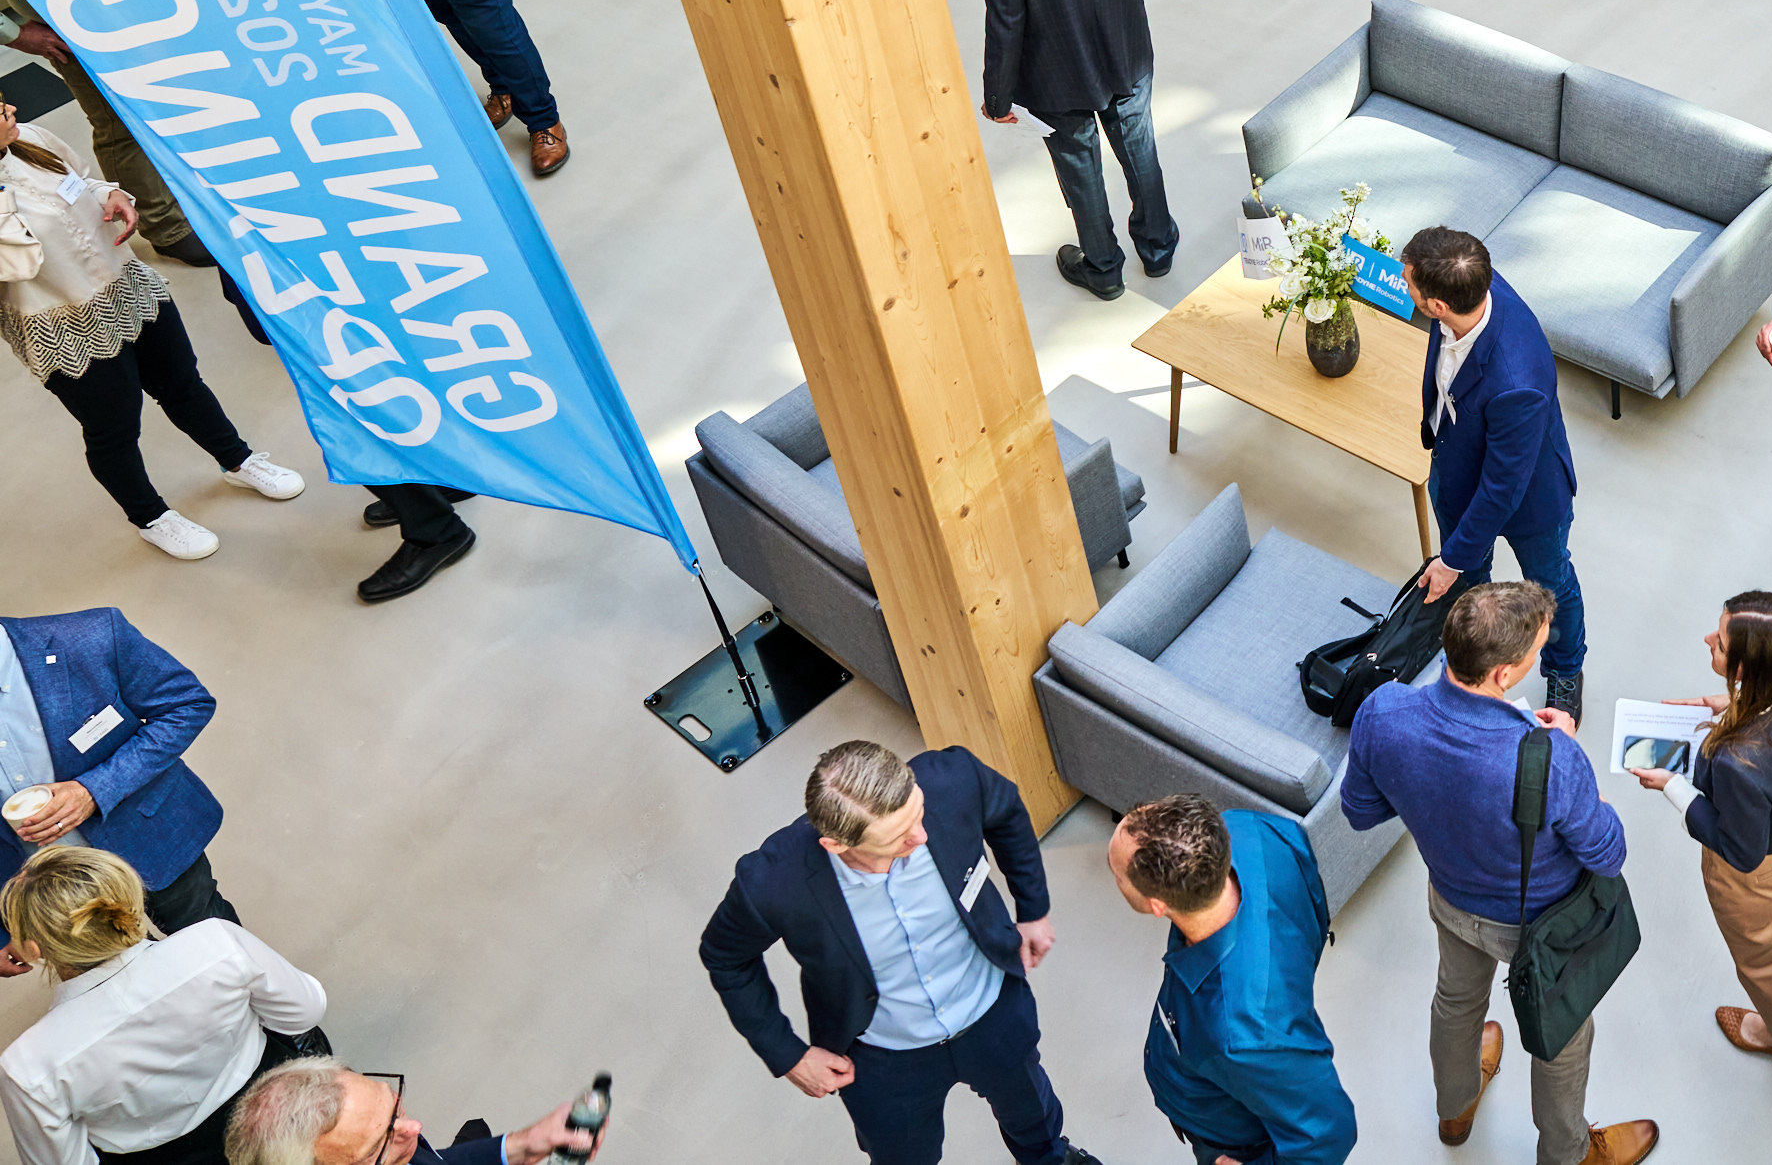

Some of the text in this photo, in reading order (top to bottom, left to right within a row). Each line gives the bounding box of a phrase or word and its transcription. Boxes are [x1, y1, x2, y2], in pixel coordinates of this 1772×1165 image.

[1353, 275, 1405, 306] ADYNE Robotics
[1378, 268, 1409, 295] MiR
